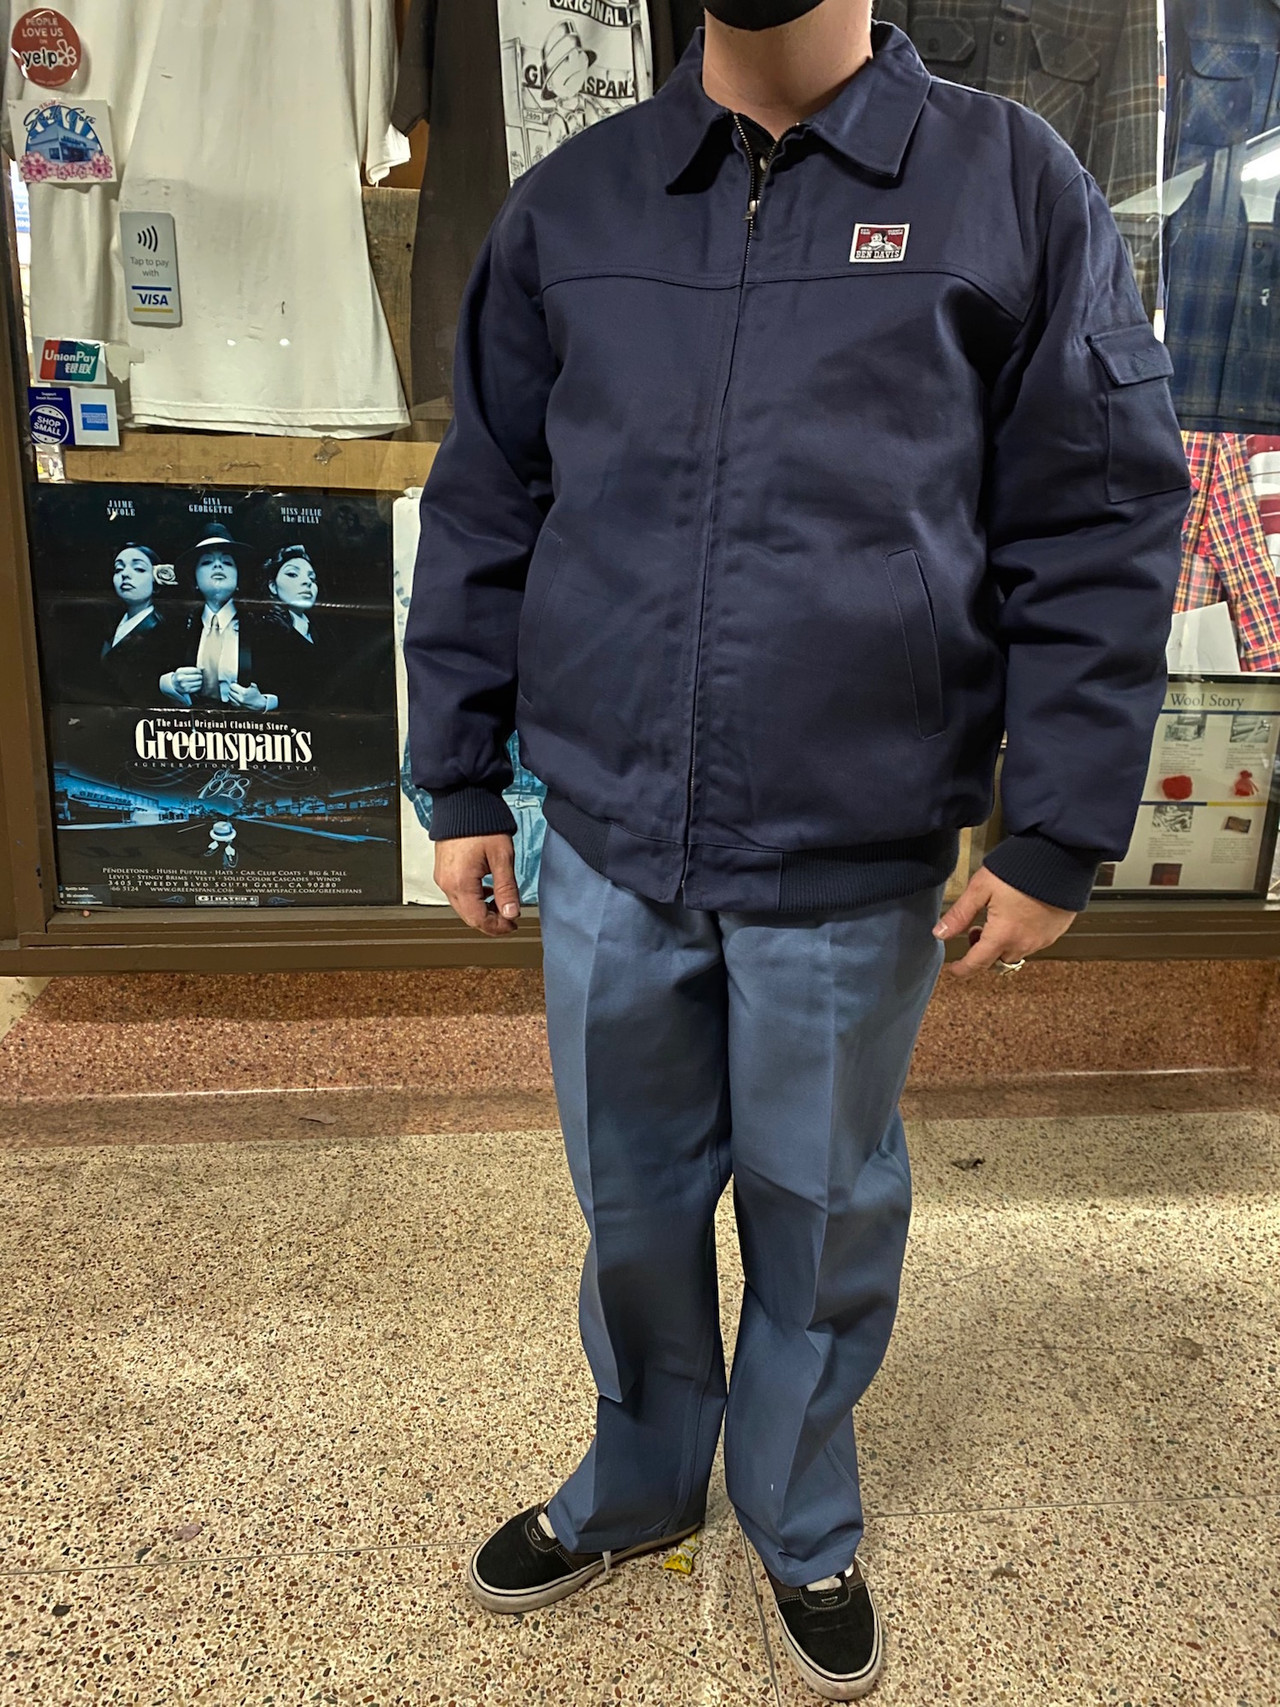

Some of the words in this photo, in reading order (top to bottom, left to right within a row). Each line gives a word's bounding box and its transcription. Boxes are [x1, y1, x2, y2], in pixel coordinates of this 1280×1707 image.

[26, 18, 58, 26] PEOPLE
[22, 28, 48, 37] LOVE
[50, 28, 64, 37] US
[22, 47, 57, 69] yelp
[856, 250, 873, 258] BEN
[874, 250, 900, 258] DAVIS
[130, 257, 145, 267] Tap
[146, 258, 155, 266] to
[156, 259, 170, 268] pay
[137, 293, 169, 306] VISA
[44, 350, 96, 367] UnionPay
[37, 415, 61, 428] SHOP
[33, 421, 62, 436] SMALL
[108, 499, 133, 508] JAIME
[189, 504, 233, 514] GEORGETTE
[281, 507, 298, 515] MISS
[1170, 692, 1205, 707] Wool
[1209, 693, 1245, 711] Story
[156, 718, 171, 727] The
[174, 719, 191, 728] Last
[195, 720, 227, 730] Original
[229, 720, 264, 731] Clothing
[266, 722, 289, 731] Store
[278, 764, 318, 772] STYLE
[197, 778, 250, 800] 1928
